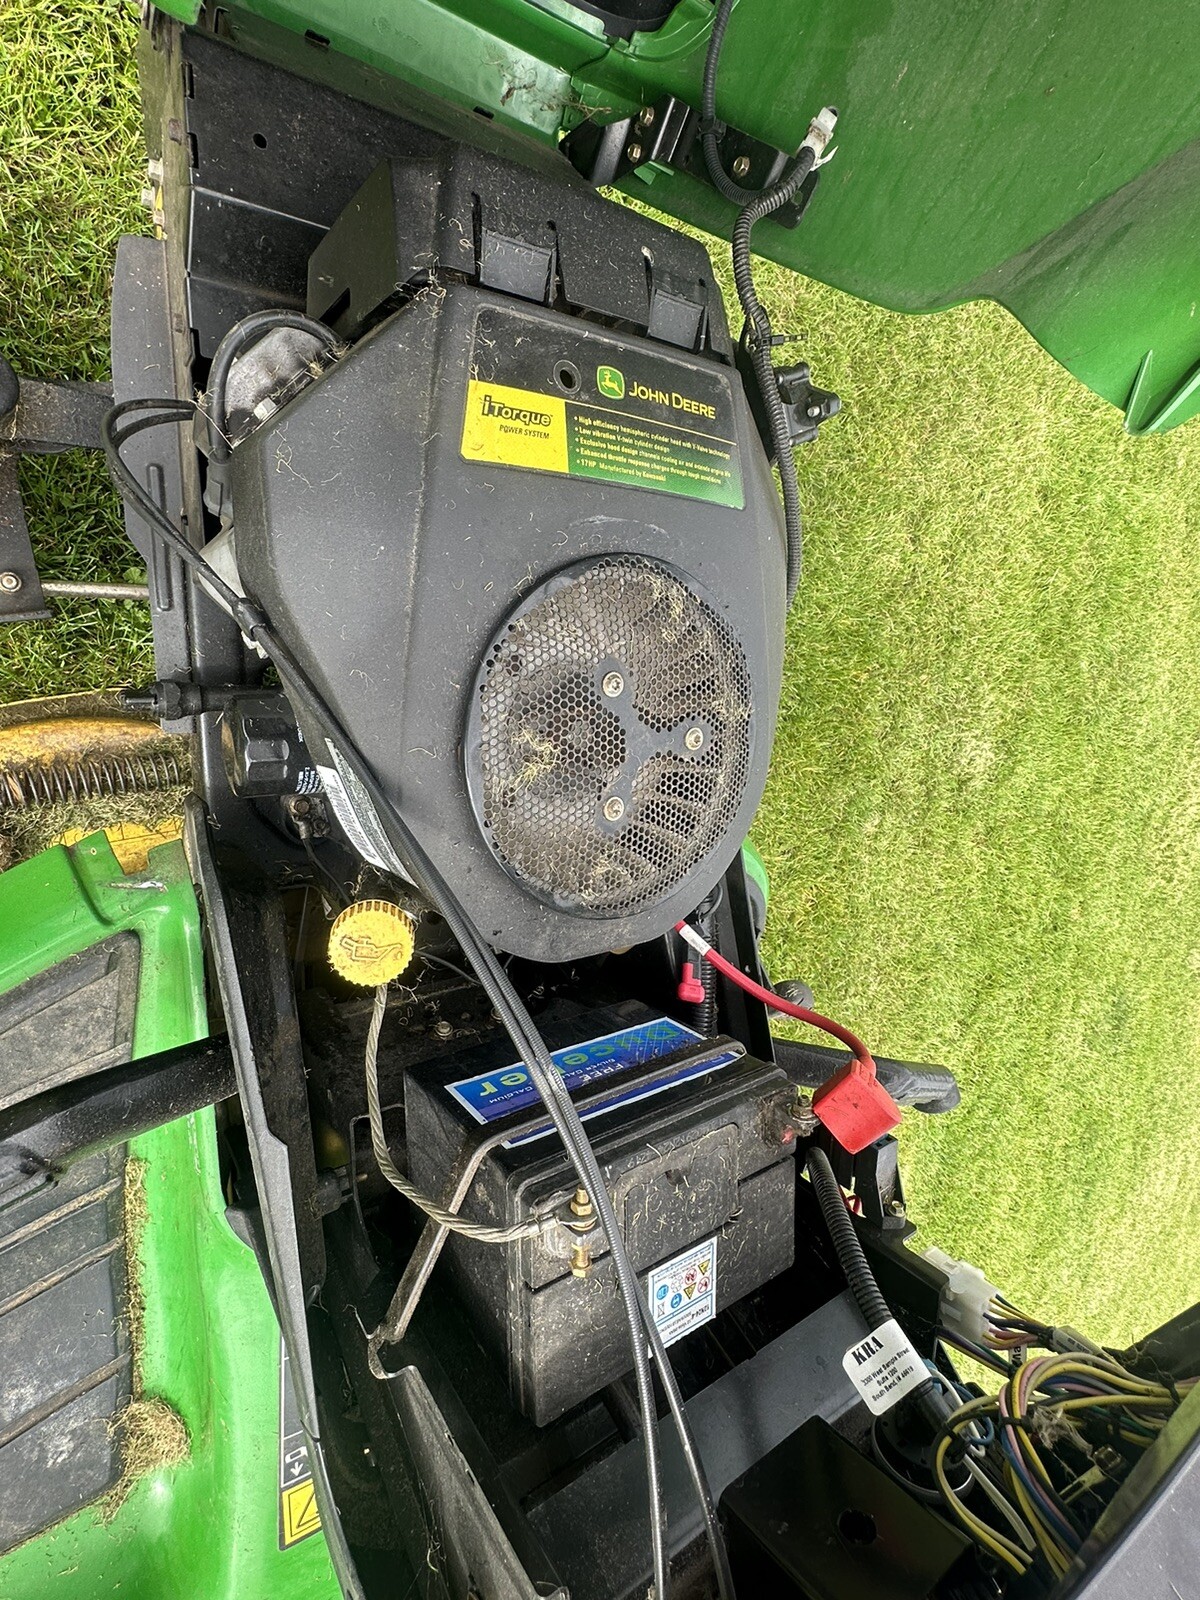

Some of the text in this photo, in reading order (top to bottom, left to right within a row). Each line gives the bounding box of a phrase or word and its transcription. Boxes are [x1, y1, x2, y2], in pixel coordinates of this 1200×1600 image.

[481, 395, 552, 426] iTorque
[628, 381, 716, 420] JOHN DEERE
[499, 424, 550, 440] POWER SYSTEM
[579, 416, 592, 426] High
[593, 419, 620, 432] efficiency
[620, 425, 650, 439] hemispheric
[651, 433, 670, 443] cylinder
[670, 437, 682, 446] head
[682, 441, 692, 449] with
[579, 426, 591, 435] Low
[592, 430, 616, 440] vibration
[634, 438, 653, 448] cylinder
[653, 443, 670, 453] design
[580, 437, 606, 448] Exclusive
[621, 446, 639, 456] design
[639, 451, 660, 461] channels
[661, 455, 678, 465] cooling
[580, 447, 607, 459] Enhanced
[608, 453, 627, 463] throttle
[627, 458, 650, 468] response
[599, 462, 635, 475] Manufactured
[635, 469, 642, 477] by
[642, 471, 667, 481] Kawasaki
[480, 1026, 681, 1097] Duceer
[489, 1058, 616, 1104] SILVER CALCIUM
[851, 1336, 884, 1366] KRA
[871, 1367, 884, 1379] West
[882, 1356, 898, 1371] Sample
[896, 1347, 910, 1359] Street
[871, 1388, 886, 1402] South
[876, 1376, 889, 1387] Suite
